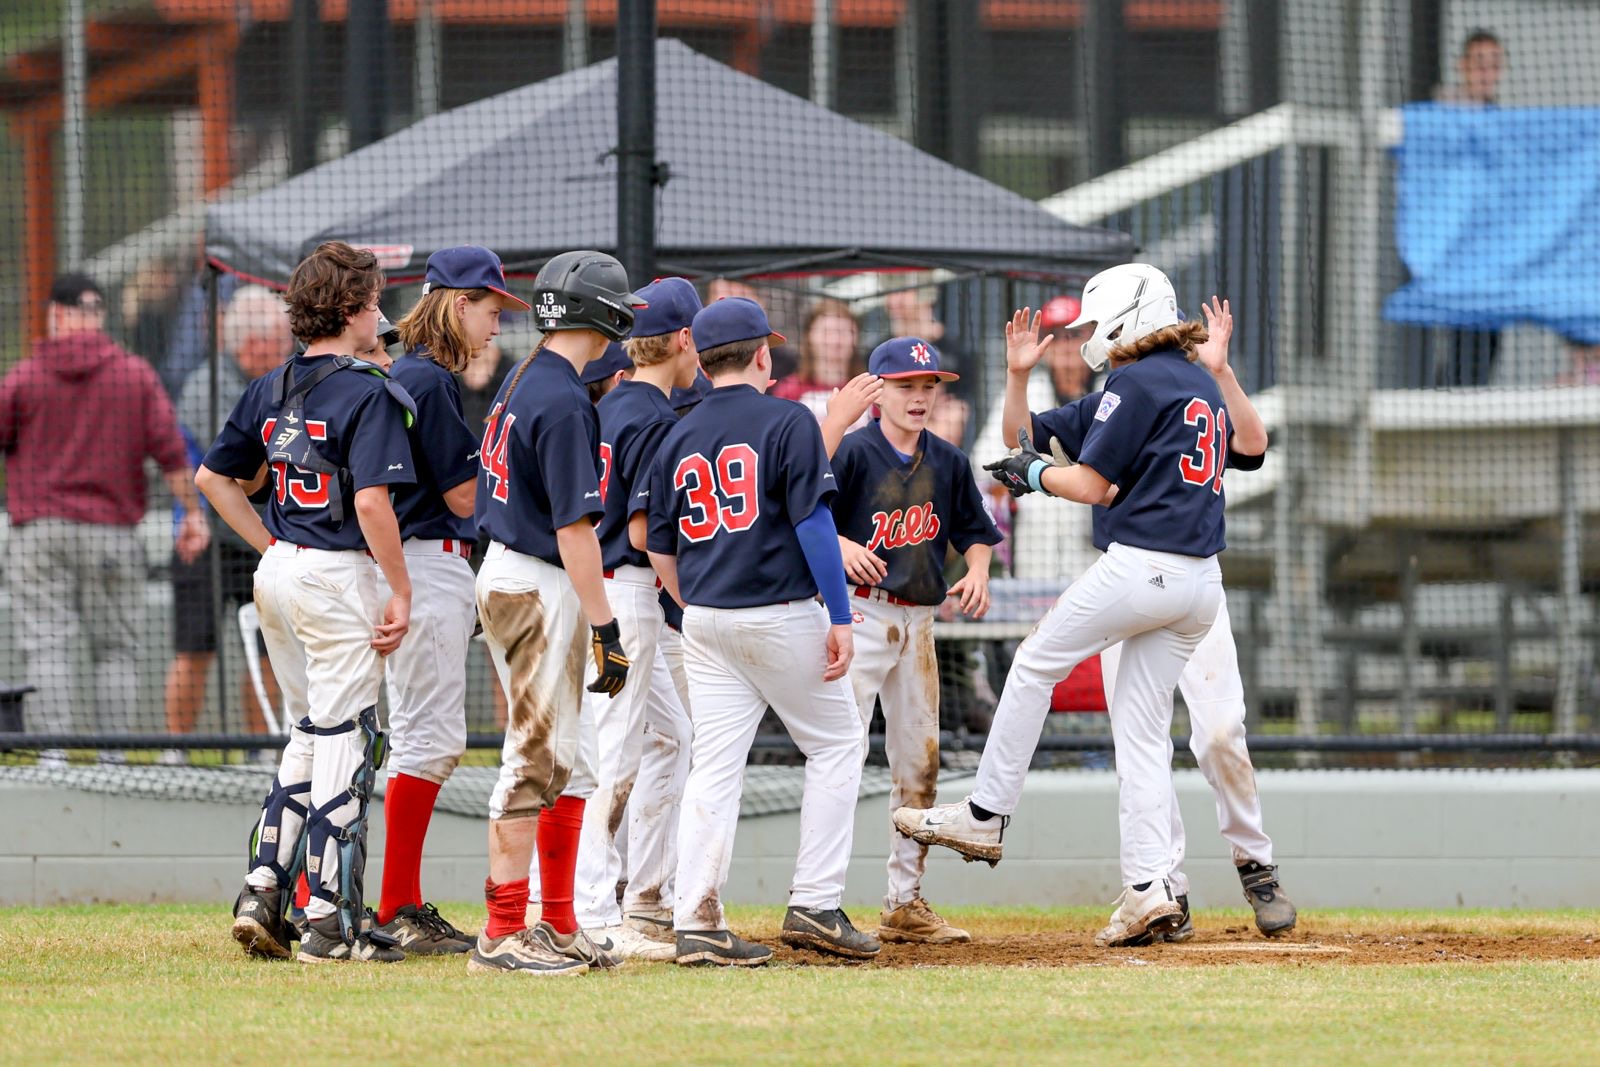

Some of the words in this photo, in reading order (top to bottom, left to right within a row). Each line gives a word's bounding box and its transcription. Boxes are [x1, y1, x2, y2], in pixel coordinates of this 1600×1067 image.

[535, 304, 567, 315] TALEN
[542, 292, 555, 305] 13
[1178, 397, 1227, 496] 31
[673, 443, 760, 543] 39
[866, 501, 941, 552] Hills
